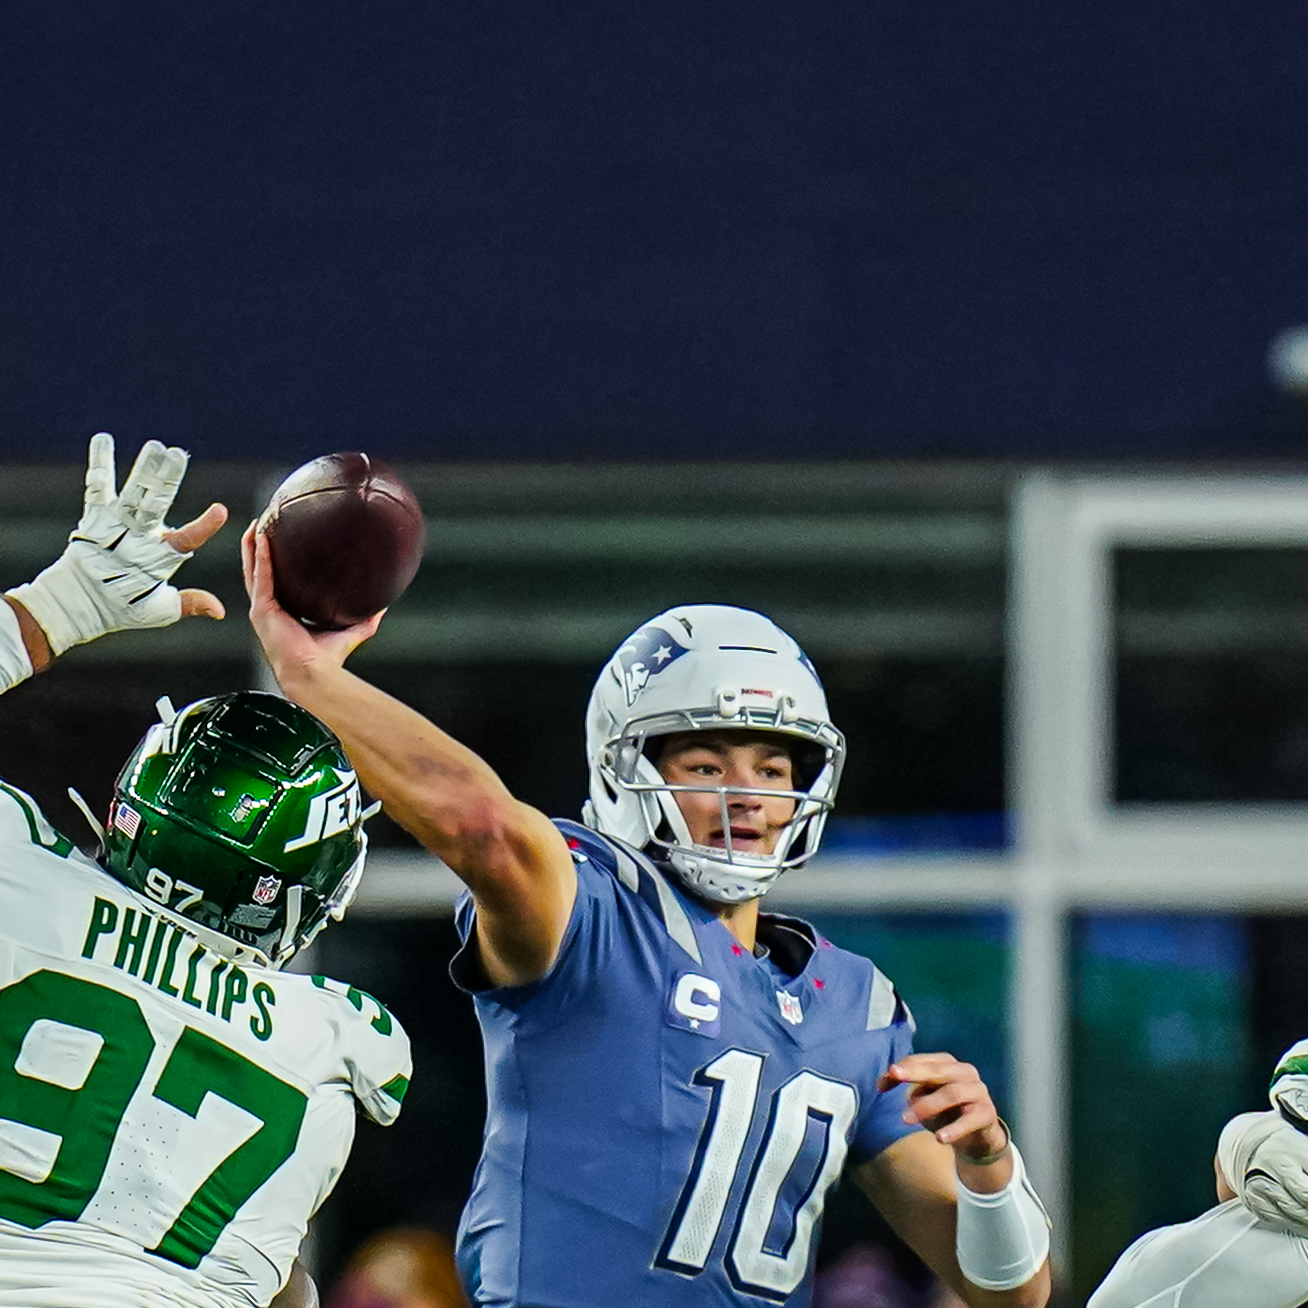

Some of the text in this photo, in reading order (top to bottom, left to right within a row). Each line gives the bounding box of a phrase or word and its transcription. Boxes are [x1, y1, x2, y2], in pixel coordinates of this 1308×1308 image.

[283, 767, 362, 853] JET
[145, 867, 204, 912] 97
[81, 896, 275, 1041] PHILLIPS
[654, 1046, 860, 1305] 10
